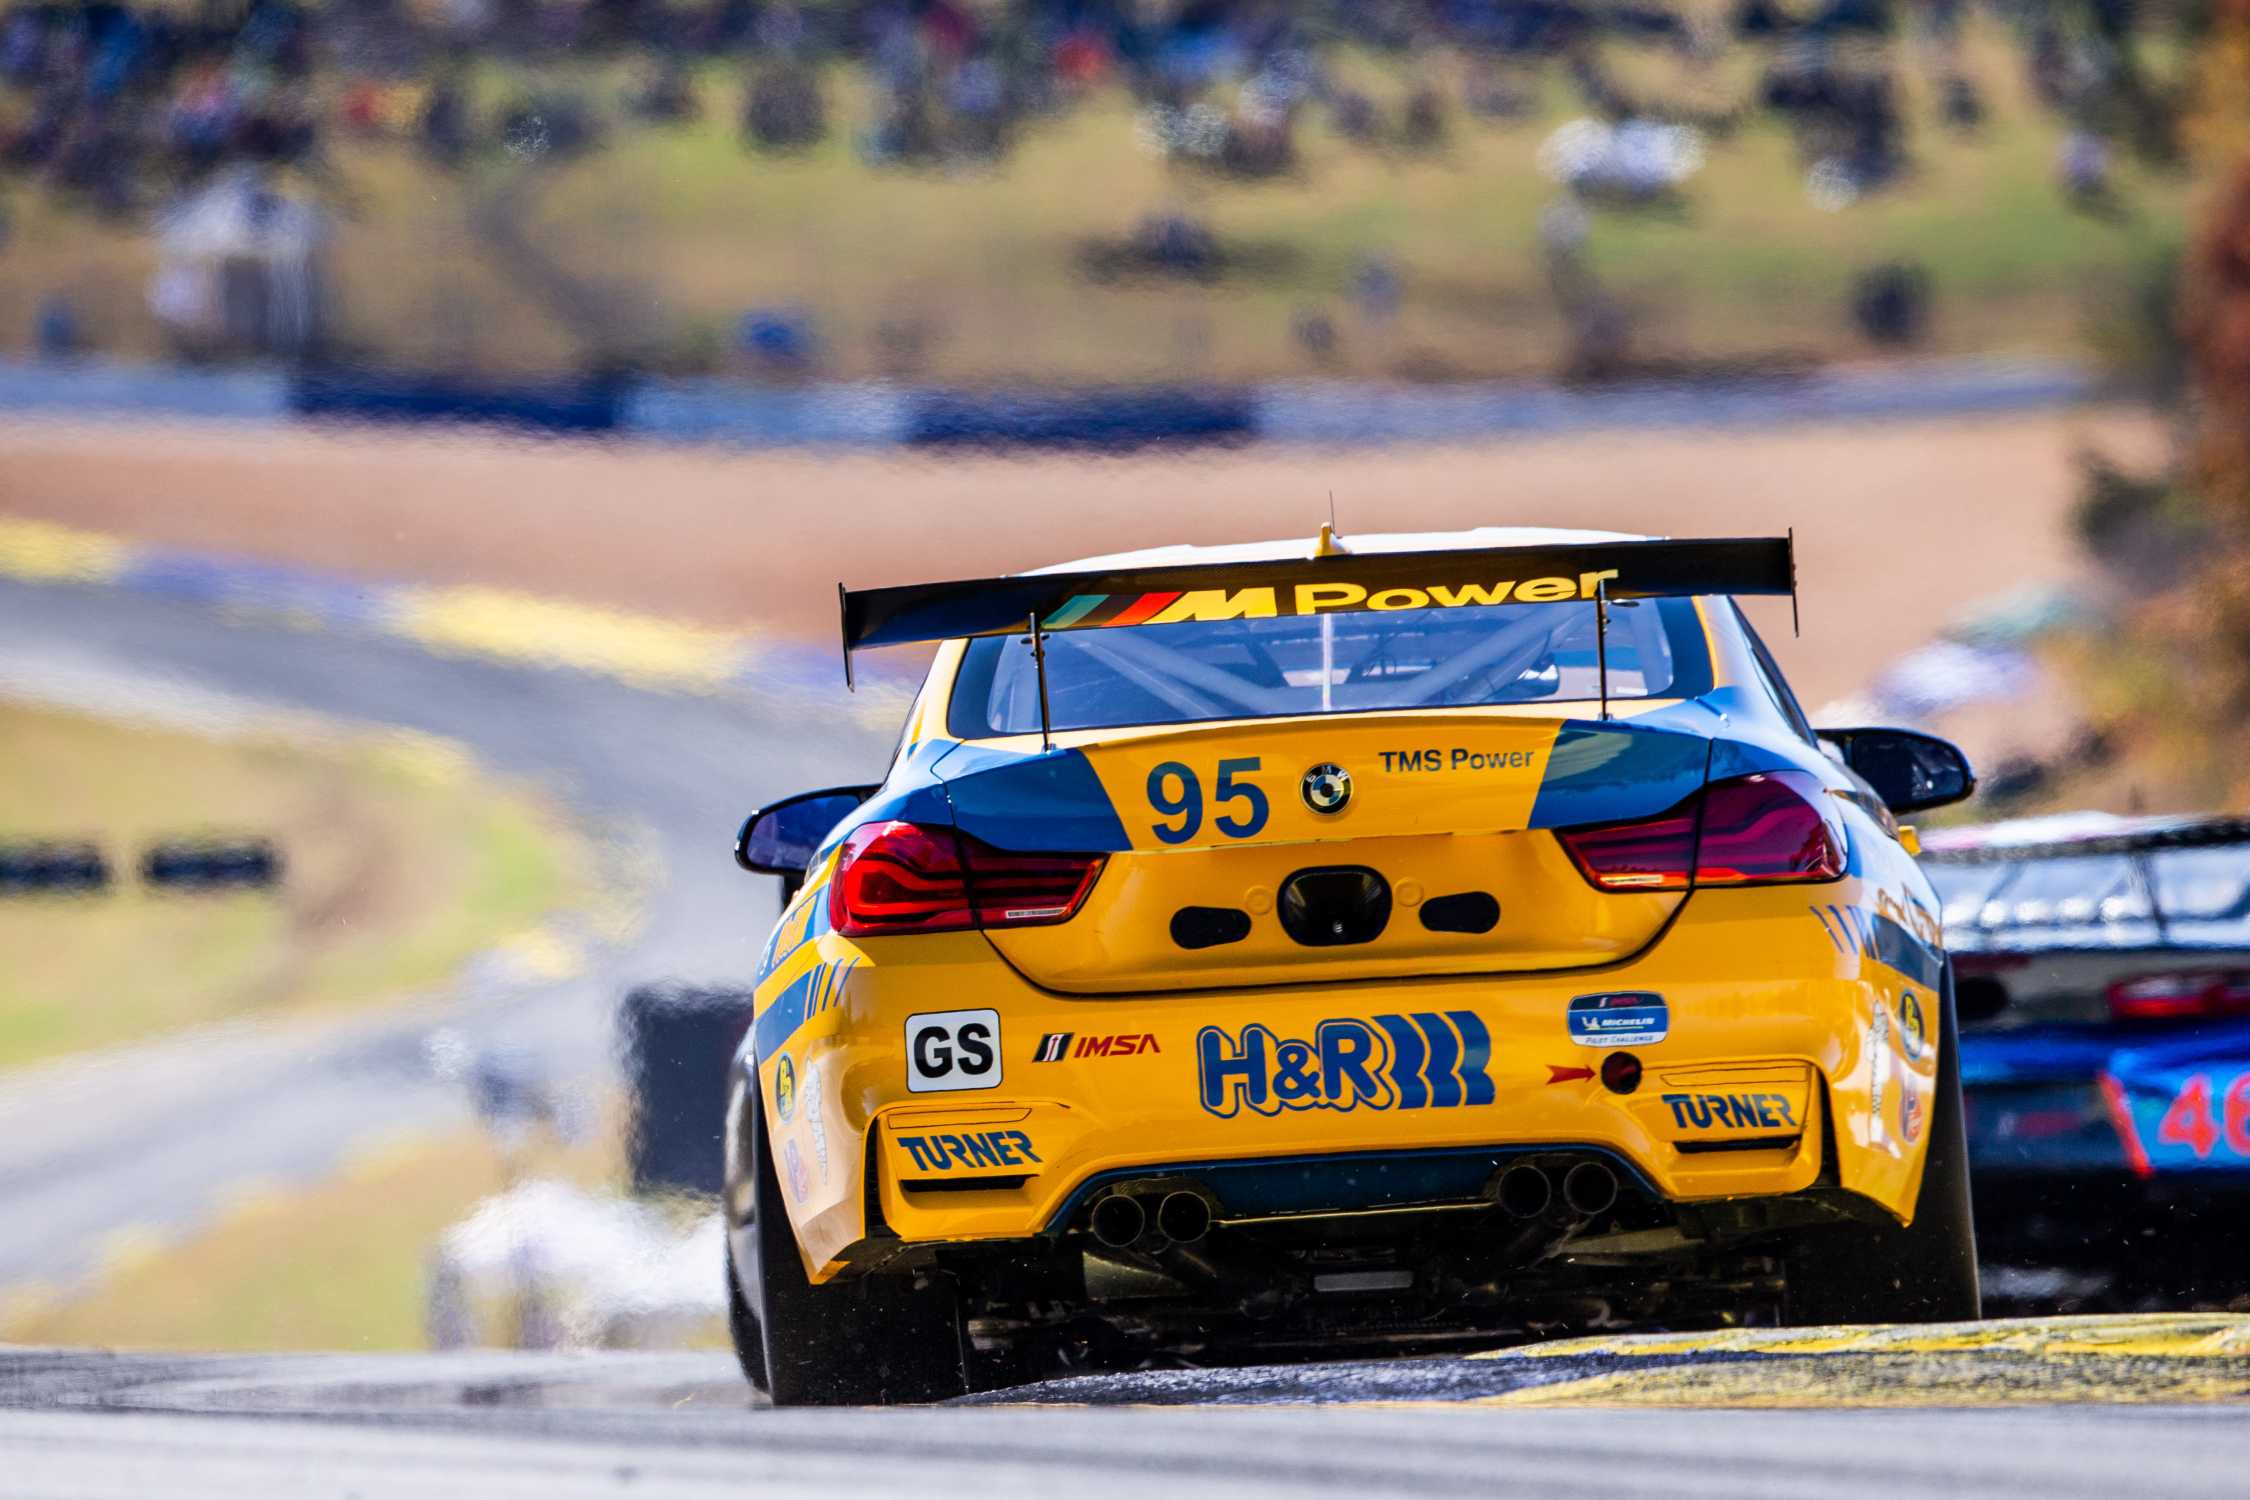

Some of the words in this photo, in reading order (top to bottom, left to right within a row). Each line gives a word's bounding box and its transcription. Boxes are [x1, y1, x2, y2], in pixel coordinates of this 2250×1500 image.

[1141, 587, 1278, 625] M
[1295, 568, 1619, 617] Power
[1378, 749, 1442, 773] TMS
[1450, 748, 1535, 770] Power
[1146, 756, 1270, 845] 95
[913, 1022, 994, 1079] GS
[1073, 1033, 1161, 1058] IMSA
[1197, 1017, 1395, 1120] H&R
[1661, 1093, 1798, 1129] TURNER
[896, 1129, 1044, 1172] TURNER
